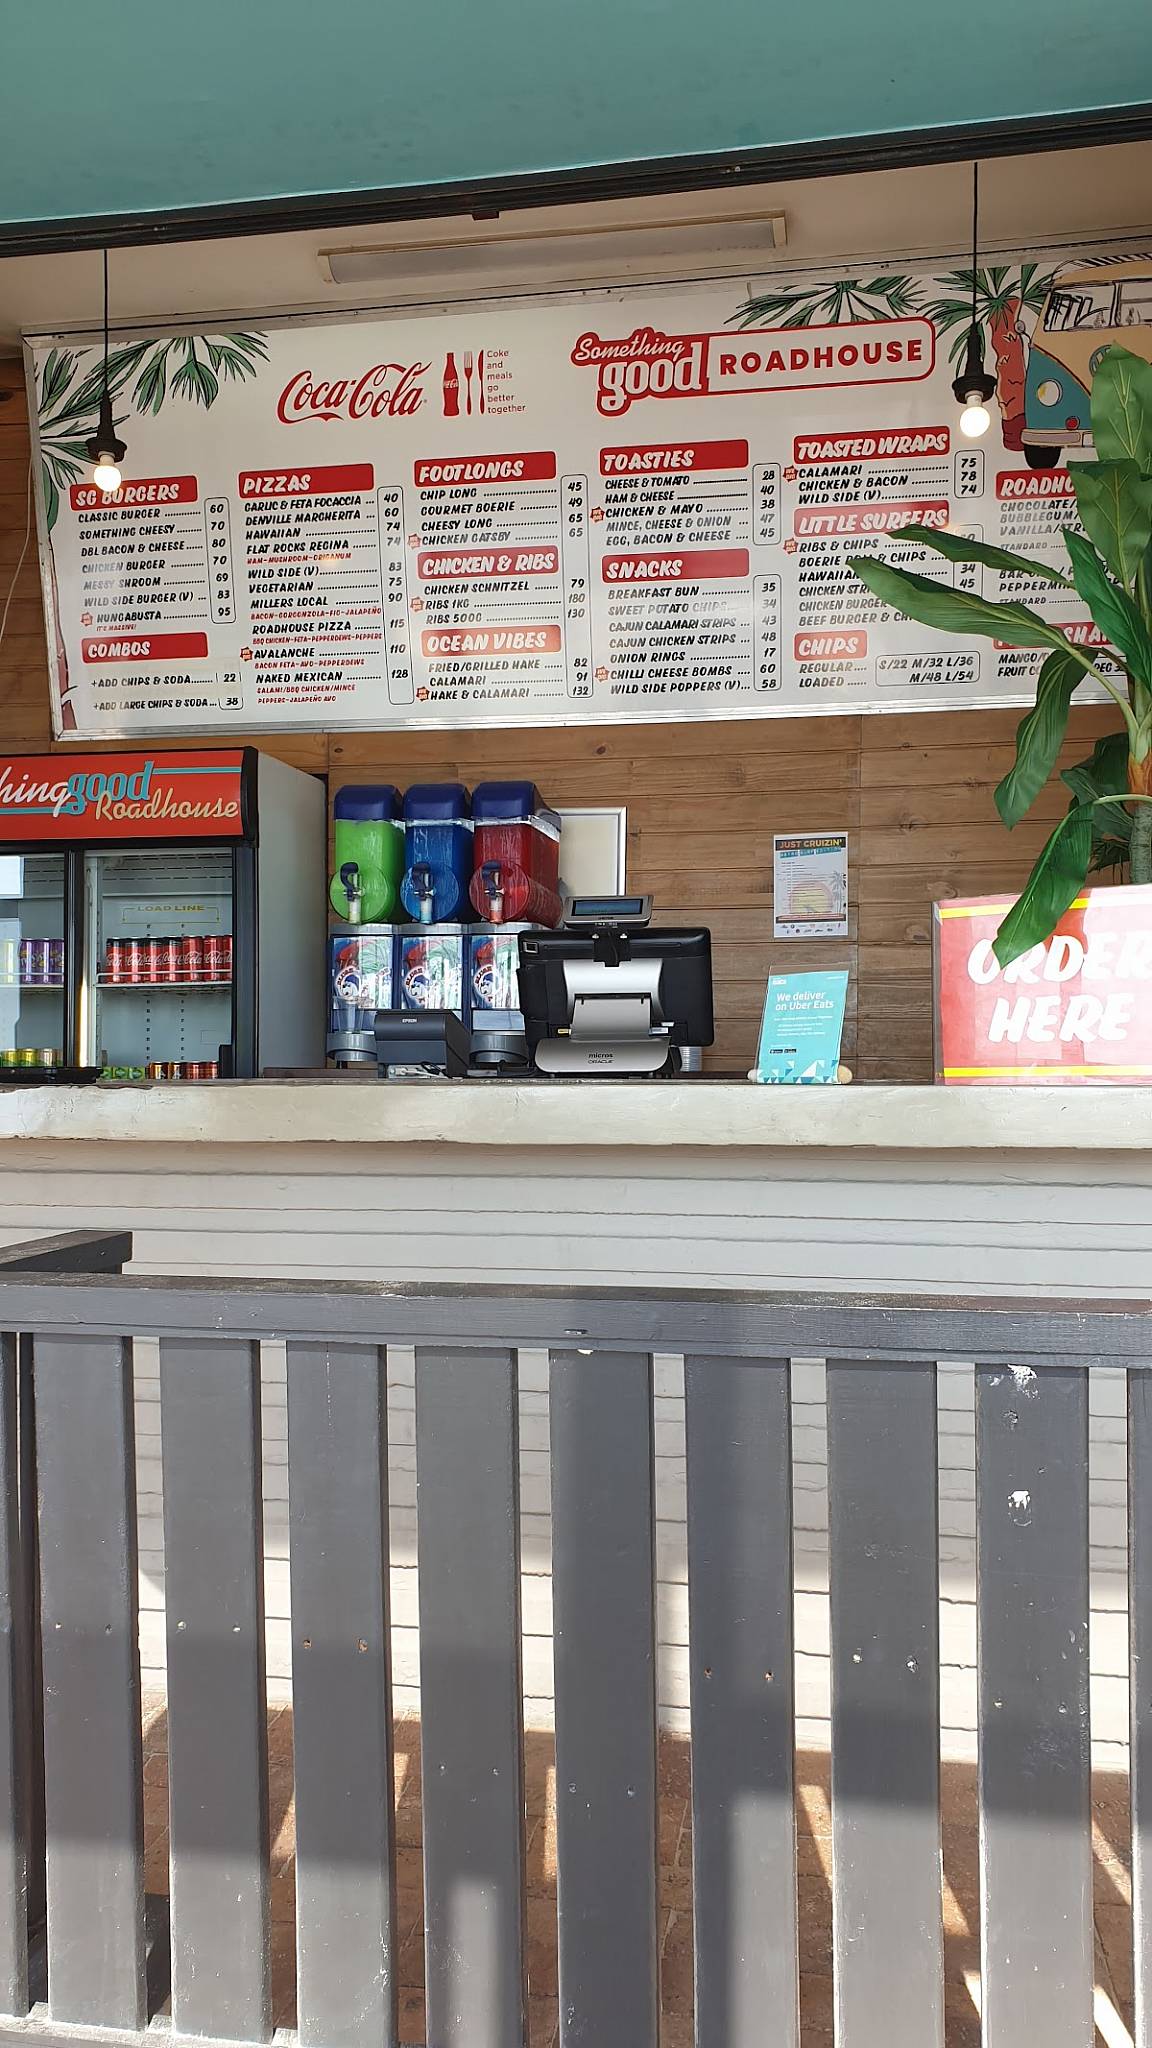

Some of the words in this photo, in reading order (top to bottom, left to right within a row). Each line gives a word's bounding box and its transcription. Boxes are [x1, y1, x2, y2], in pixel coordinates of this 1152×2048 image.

[487, 350, 509, 358] Coke
[575, 333, 684, 361] Something
[487, 360, 503, 369] and
[720, 340, 922, 375] ROADHOUSE
[487, 371, 512, 380] meals
[601, 342, 702, 411] good
[277, 361, 432, 424] Coca-Cola
[488, 384, 498, 392] go
[488, 394, 515, 402] better
[488, 404, 526, 415] together
[798, 438, 876, 460] TOASTED
[878, 433, 947, 452] WRAPS
[604, 450, 694, 472] TOASTIES
[419, 460, 524, 482] FOOTLONGS
[799, 465, 862, 478] CALAMARI
[244, 474, 310, 494] PIZZAS
[605, 479, 639, 489] CHEESE
[651, 476, 689, 487] TOMATO
[799, 479, 850, 491] CHICKEN
[866, 476, 908, 488] BACON
[961, 471, 976, 481] 78
[102, 484, 179, 504] BURGERS
[421, 490, 445, 500] CHIP
[568, 482, 582, 491] 45
[640, 491, 674, 501] CHEESE
[761, 486, 774, 494] 40
[799, 493, 830, 504] WILD
[832, 491, 860, 502] SIDE
[290, 499, 312, 510] FETA
[314, 496, 361, 508] FOCACCIA
[384, 493, 398, 502] 40
[421, 504, 473, 516] GOURMET
[476, 501, 515, 512] BOERIE
[568, 498, 582, 507] 49
[79, 512, 118, 523] CLASSIC
[121, 509, 160, 520] BURGER
[210, 504, 224, 513] 60
[246, 514, 292, 525] DENVILLE
[385, 508, 399, 517] 60
[606, 507, 654, 518] CHICKEN
[670, 504, 703, 515] MAYO
[422, 520, 460, 531] CHEESY
[569, 514, 582, 522] 65
[645, 519, 682, 530] CHEESE
[697, 517, 730, 527] ONION
[760, 514, 774, 523] 47
[799, 514, 857, 534] LITTLE
[860, 509, 947, 530] SURFERS
[80, 528, 136, 539] SOMETHING
[139, 524, 175, 536] CHEESY
[211, 521, 225, 530] 70
[246, 528, 301, 539] HAWAIIAN
[387, 522, 400, 531] 74
[423, 534, 468, 545] CHICKEN
[569, 528, 583, 537] 65
[634, 534, 673, 544] BACON
[689, 531, 730, 541] CHEESE
[102, 544, 135, 555] BACON
[149, 541, 184, 552] CHEESE
[212, 539, 225, 547] 80
[247, 545, 270, 554] FLAT
[273, 542, 305, 553] ROCKS
[800, 542, 826, 552] RIBS
[843, 539, 879, 549] CHIPS
[126, 560, 165, 570] BURGER
[213, 556, 227, 565] 70
[423, 556, 495, 576] CHICKEN
[515, 553, 555, 570] RIBS
[799, 557, 841, 567] BOERIE
[891, 552, 926, 562] CHIPS
[248, 569, 274, 579] WILD
[277, 567, 301, 577] SIDE
[606, 560, 683, 578] SNACKS
[119, 578, 161, 588] SHROOM
[216, 573, 228, 582] 69
[249, 582, 314, 593] VEGETARIAN
[389, 577, 402, 586] 75
[425, 584, 469, 595] CHICKEN
[471, 581, 530, 593] SCHNITZEL
[571, 579, 584, 588] 79
[608, 588, 672, 600] BREAKFAST
[675, 586, 699, 597] BUN
[762, 583, 775, 592] 35
[799, 585, 844, 596] CHICKEN
[112, 595, 133, 605] SIDE
[137, 593, 176, 604] BURGER
[251, 598, 294, 609] MILLERS
[297, 597, 328, 607] LOCAL
[426, 600, 448, 610] RIBS
[799, 601, 843, 611] CHICKEN
[97, 611, 161, 623] HUNGABUSTA
[218, 608, 230, 616] 95
[568, 609, 584, 618] 130
[608, 605, 645, 616] SWEET
[648, 603, 688, 614] POTATO
[253, 623, 314, 634] ROADHOUSE
[318, 621, 351, 632] PIZZA
[609, 621, 643, 632] CAJUN
[645, 620, 698, 630] CALAMARI
[701, 618, 736, 628] STRIPS
[762, 616, 776, 625] 43
[799, 615, 826, 626] BEEF
[427, 634, 489, 652] OCEAN
[493, 632, 546, 649] VIBES
[610, 637, 646, 648] CAJUN
[649, 636, 695, 646] CHICKEN
[697, 634, 736, 644] STRIPS
[798, 637, 858, 656] CHIPS
[88, 641, 150, 658] COMBOS
[254, 648, 315, 659] AVALANCHE
[390, 645, 405, 653] 110
[610, 653, 647, 663] ONION
[764, 648, 776, 657] 17
[512, 660, 540, 669] HAKE
[574, 658, 587, 667] 82
[122, 676, 150, 685] CHIPS
[224, 674, 235, 682] 22
[256, 674, 290, 683] NAKED
[294, 672, 342, 682] MEXICAN
[392, 670, 408, 678] 128
[648, 668, 688, 678] CHEESE
[692, 666, 732, 676] BOMBS
[430, 676, 486, 686] CALAMARI
[611, 683, 638, 694] WILD
[642, 683, 666, 693] SIDE
[670, 682, 721, 692] POPPERS
[762, 679, 776, 688] 58
[799, 677, 844, 687] LOADED
[431, 690, 458, 700] HAKE
[473, 688, 529, 698] CALAMARI
[573, 687, 588, 695] 132
[148, 700, 173, 708] CHIPS
[68, 760, 154, 815] good
[95, 788, 239, 820] Roadhouse
[804, 839, 842, 847] CRUIZIN'
[967, 930, 1152, 985] ORDER
[777, 993, 790, 1001] We
[793, 992, 826, 1001] deliver
[789, 1001, 811, 1010] Uber
[814, 1000, 834, 1008] Eats
[988, 993, 1135, 1043] HERE
